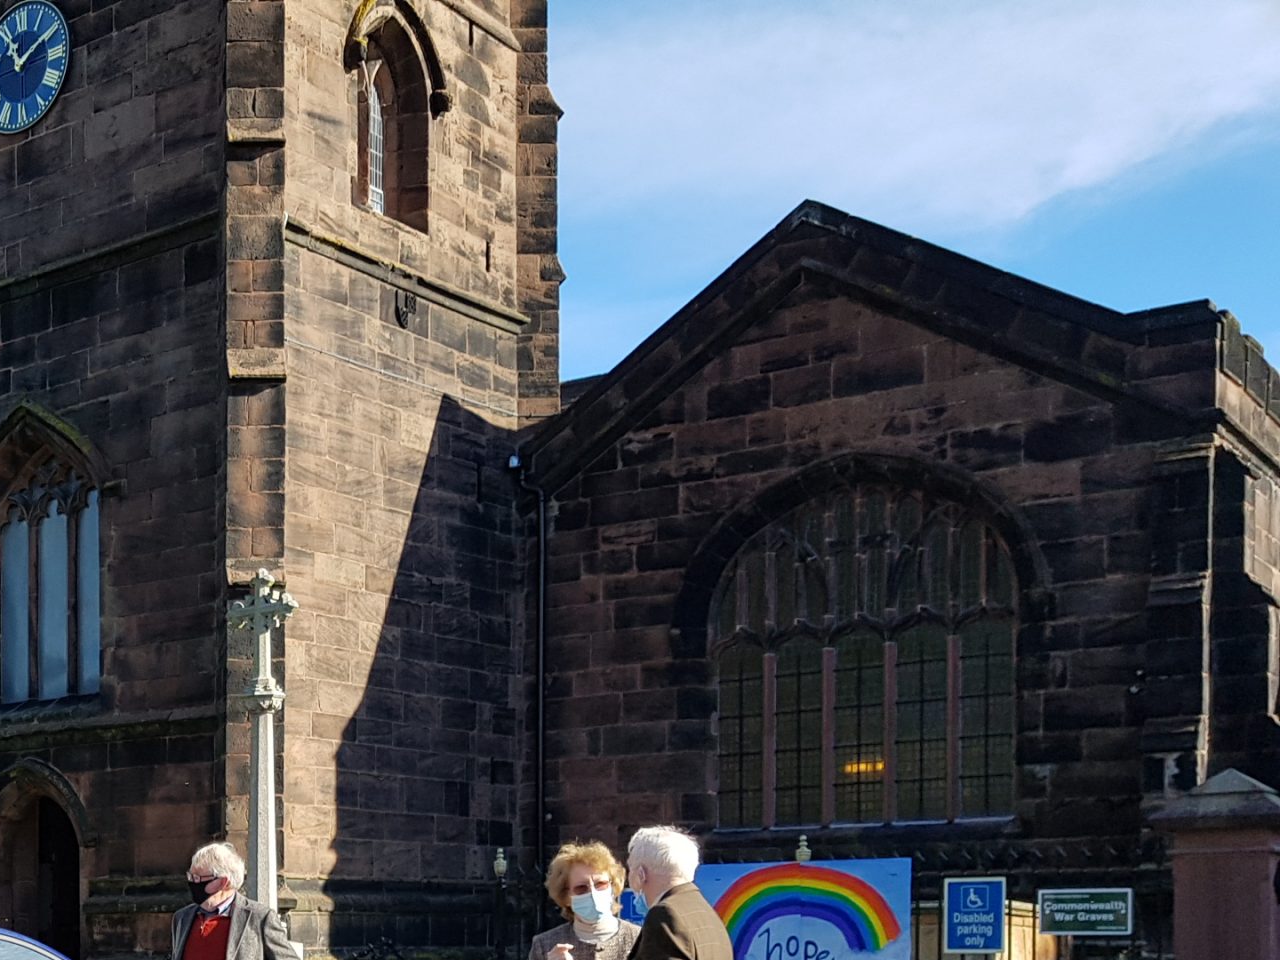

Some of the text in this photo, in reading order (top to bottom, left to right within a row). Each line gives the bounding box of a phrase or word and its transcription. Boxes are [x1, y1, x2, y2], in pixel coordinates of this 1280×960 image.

[1043, 900, 1126, 911] Commonwealth
[953, 911, 994, 923] Disabled
[1054, 911, 1114, 921] War Graves
[956, 923, 993, 937] parking
[964, 935, 985, 948] only
